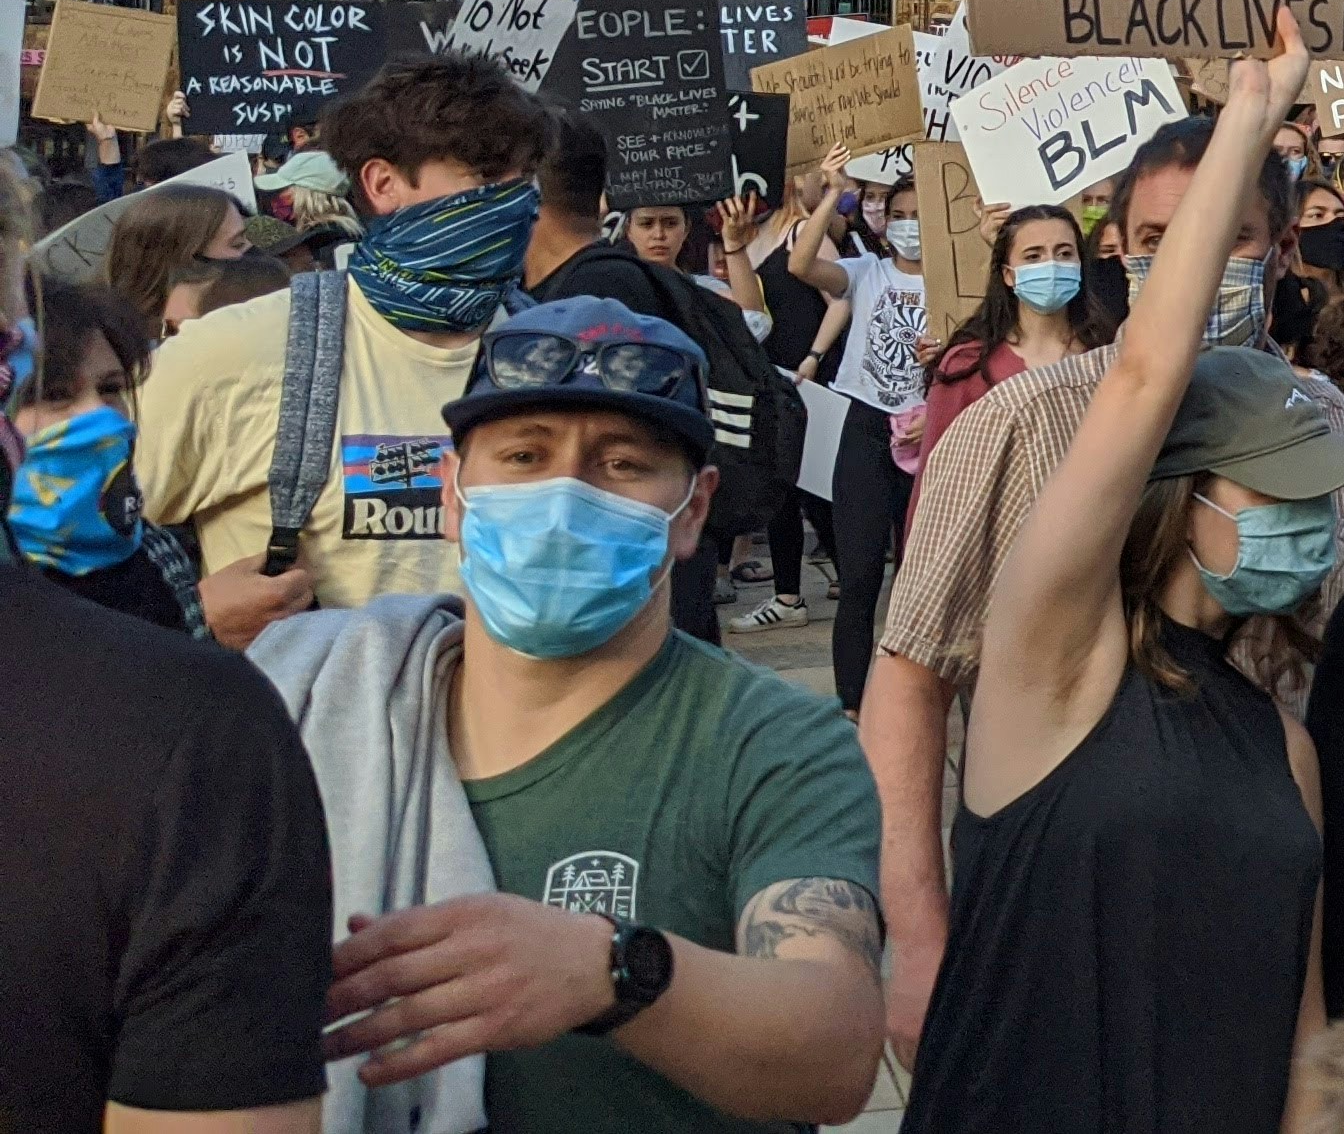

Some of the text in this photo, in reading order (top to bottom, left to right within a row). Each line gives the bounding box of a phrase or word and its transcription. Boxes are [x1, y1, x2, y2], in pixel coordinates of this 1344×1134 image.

[196, 2, 372, 36] SKIN COLOR
[720, 5, 793, 24] LIVES
[258, 36, 339, 72] NOT
[582, 56, 670, 85] START
[186, 74, 338, 95] A REASONABLE
[680, 87, 717, 102] LIVES
[979, 59, 1073, 131] Silence
[617, 135, 646, 150] SEE
[1037, 78, 1175, 191] BLM
[619, 149, 660, 164] YOUR
